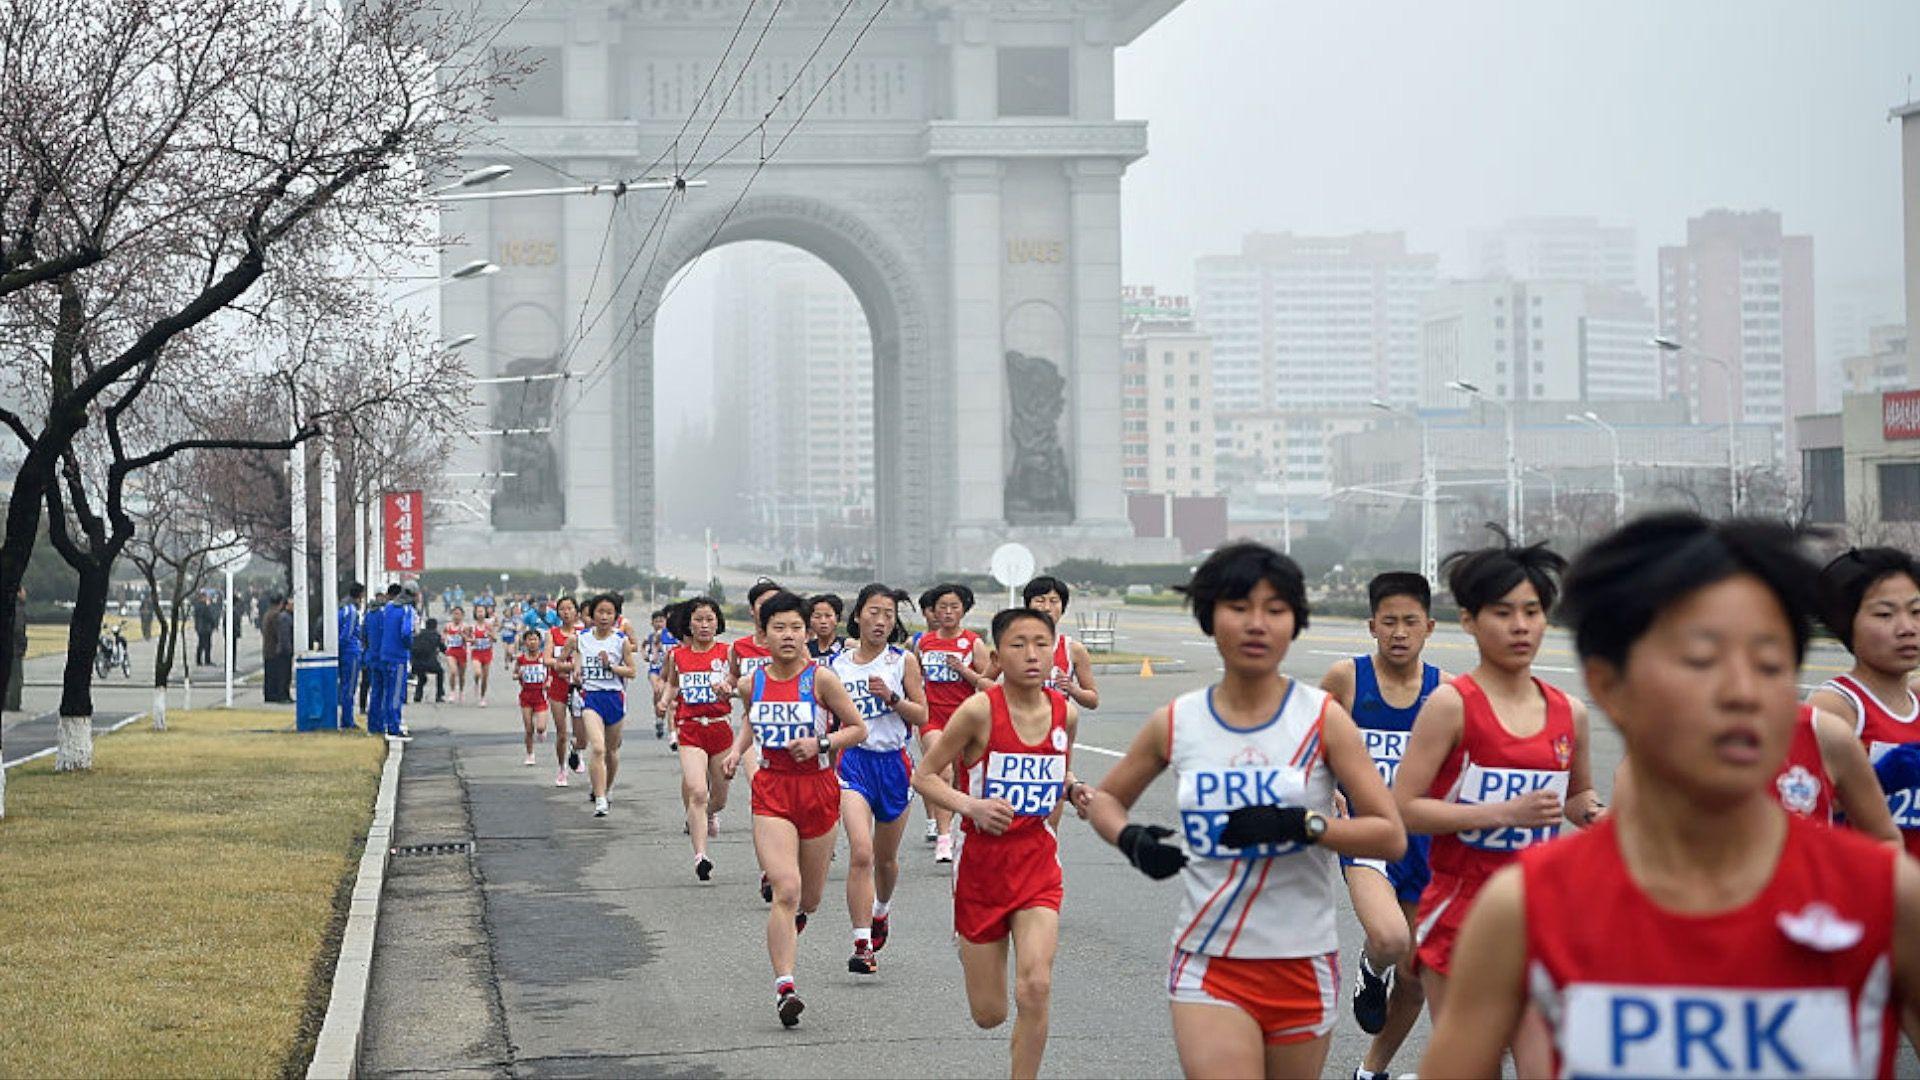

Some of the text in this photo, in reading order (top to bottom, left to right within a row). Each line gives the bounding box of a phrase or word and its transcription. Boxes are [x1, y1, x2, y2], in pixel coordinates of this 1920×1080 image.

[586, 656, 601, 667] PR
[747, 658, 769, 672] PR
[845, 680, 870, 696] PR
[759, 704, 800, 721] PRK
[1366, 732, 1410, 756] PR
[1001, 756, 1054, 780] PRK
[1197, 770, 1281, 806] PRK
[1478, 771, 1553, 801] PRK
[1187, 814, 1294, 855] 32
[1609, 996, 1802, 1072] PRK
